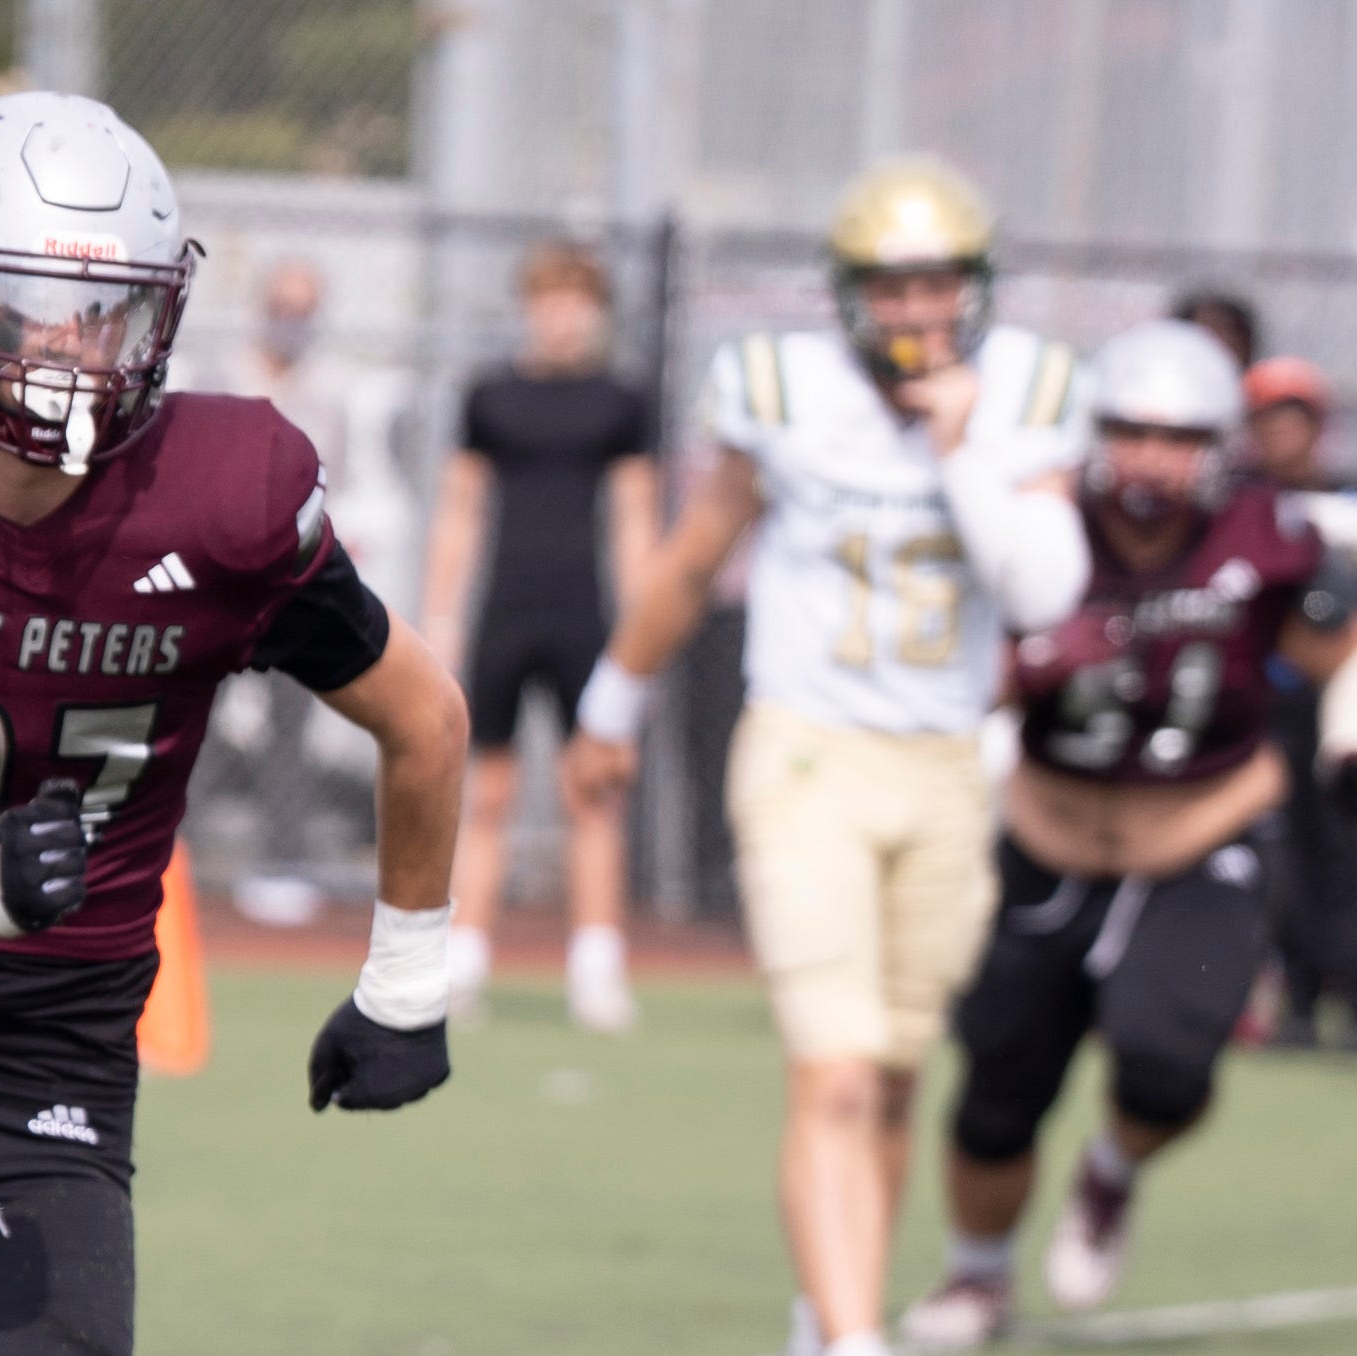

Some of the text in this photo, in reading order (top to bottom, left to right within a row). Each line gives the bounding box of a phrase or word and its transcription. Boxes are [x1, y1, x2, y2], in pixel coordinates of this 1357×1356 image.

[44, 237, 116, 260] Riddell
[18, 616, 186, 675] PETERS
[27, 1118, 99, 1146] adidas
